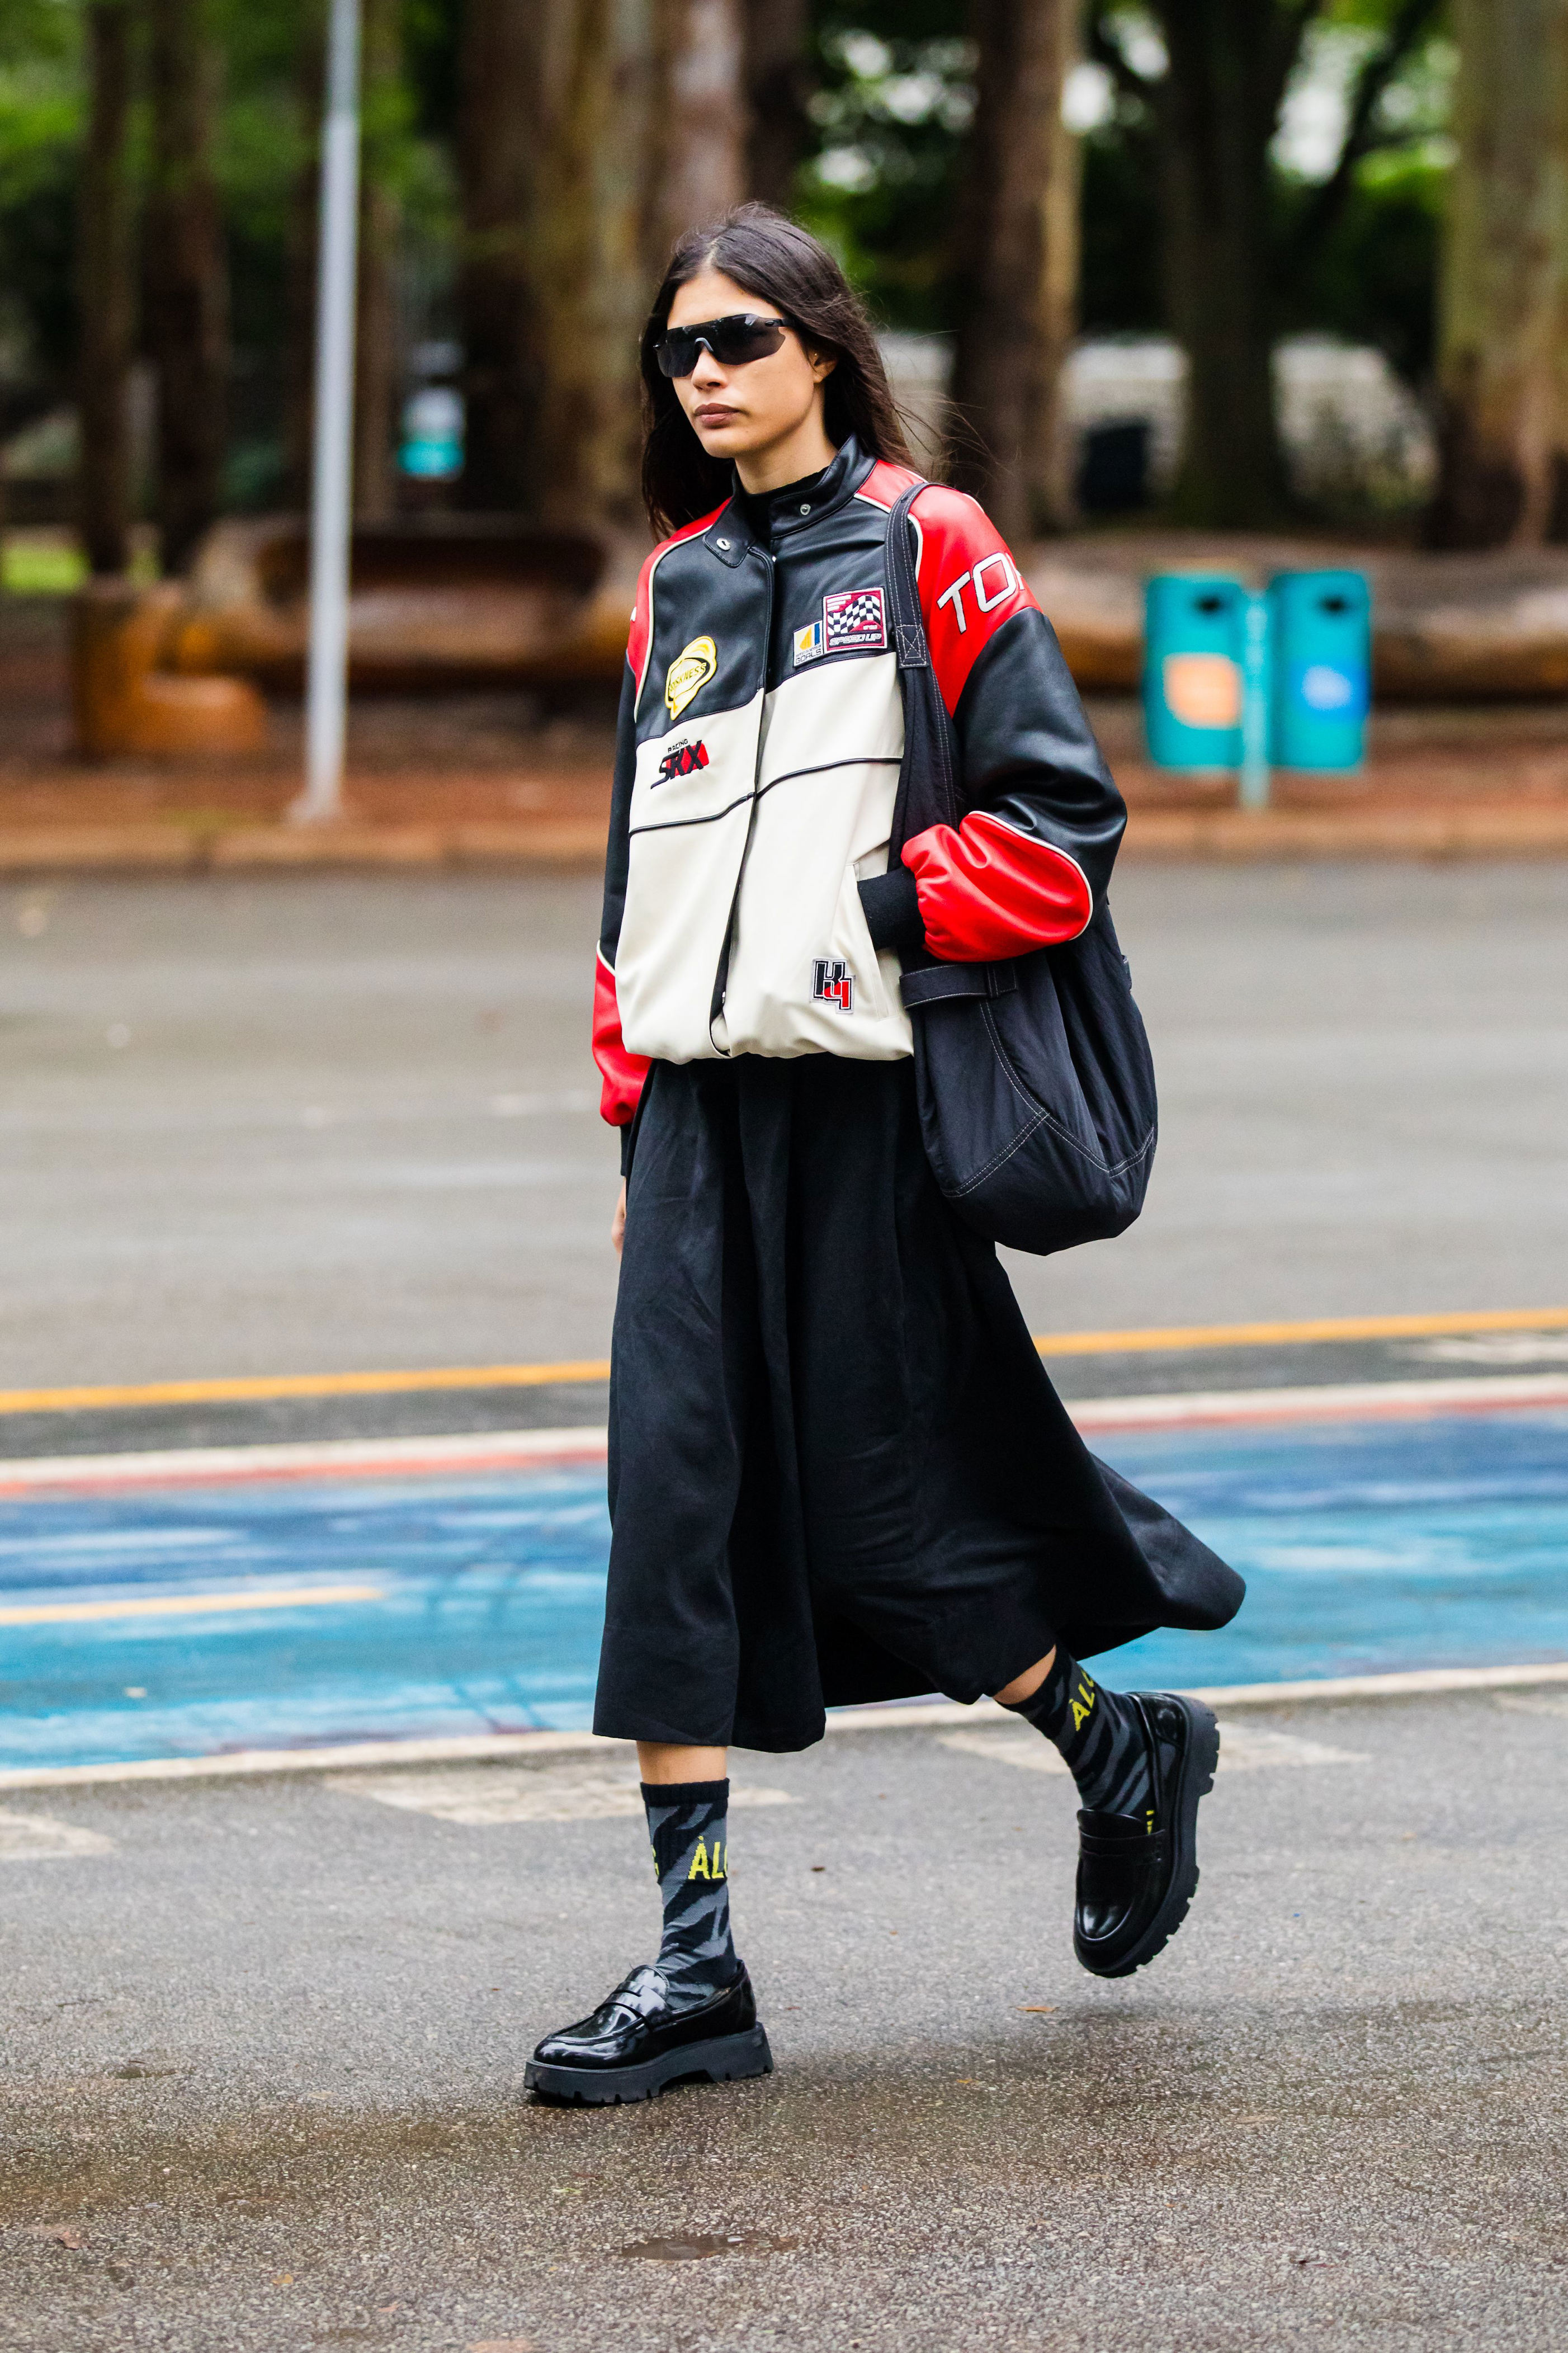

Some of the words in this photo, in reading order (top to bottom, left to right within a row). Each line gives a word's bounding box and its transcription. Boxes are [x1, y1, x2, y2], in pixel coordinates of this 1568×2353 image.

[937, 551, 1025, 635] TO
[829, 633, 866, 646] SPEED
[865, 633, 882, 642] UP
[795, 648, 821, 664] GOALS
[668, 739, 688, 753] RACING
